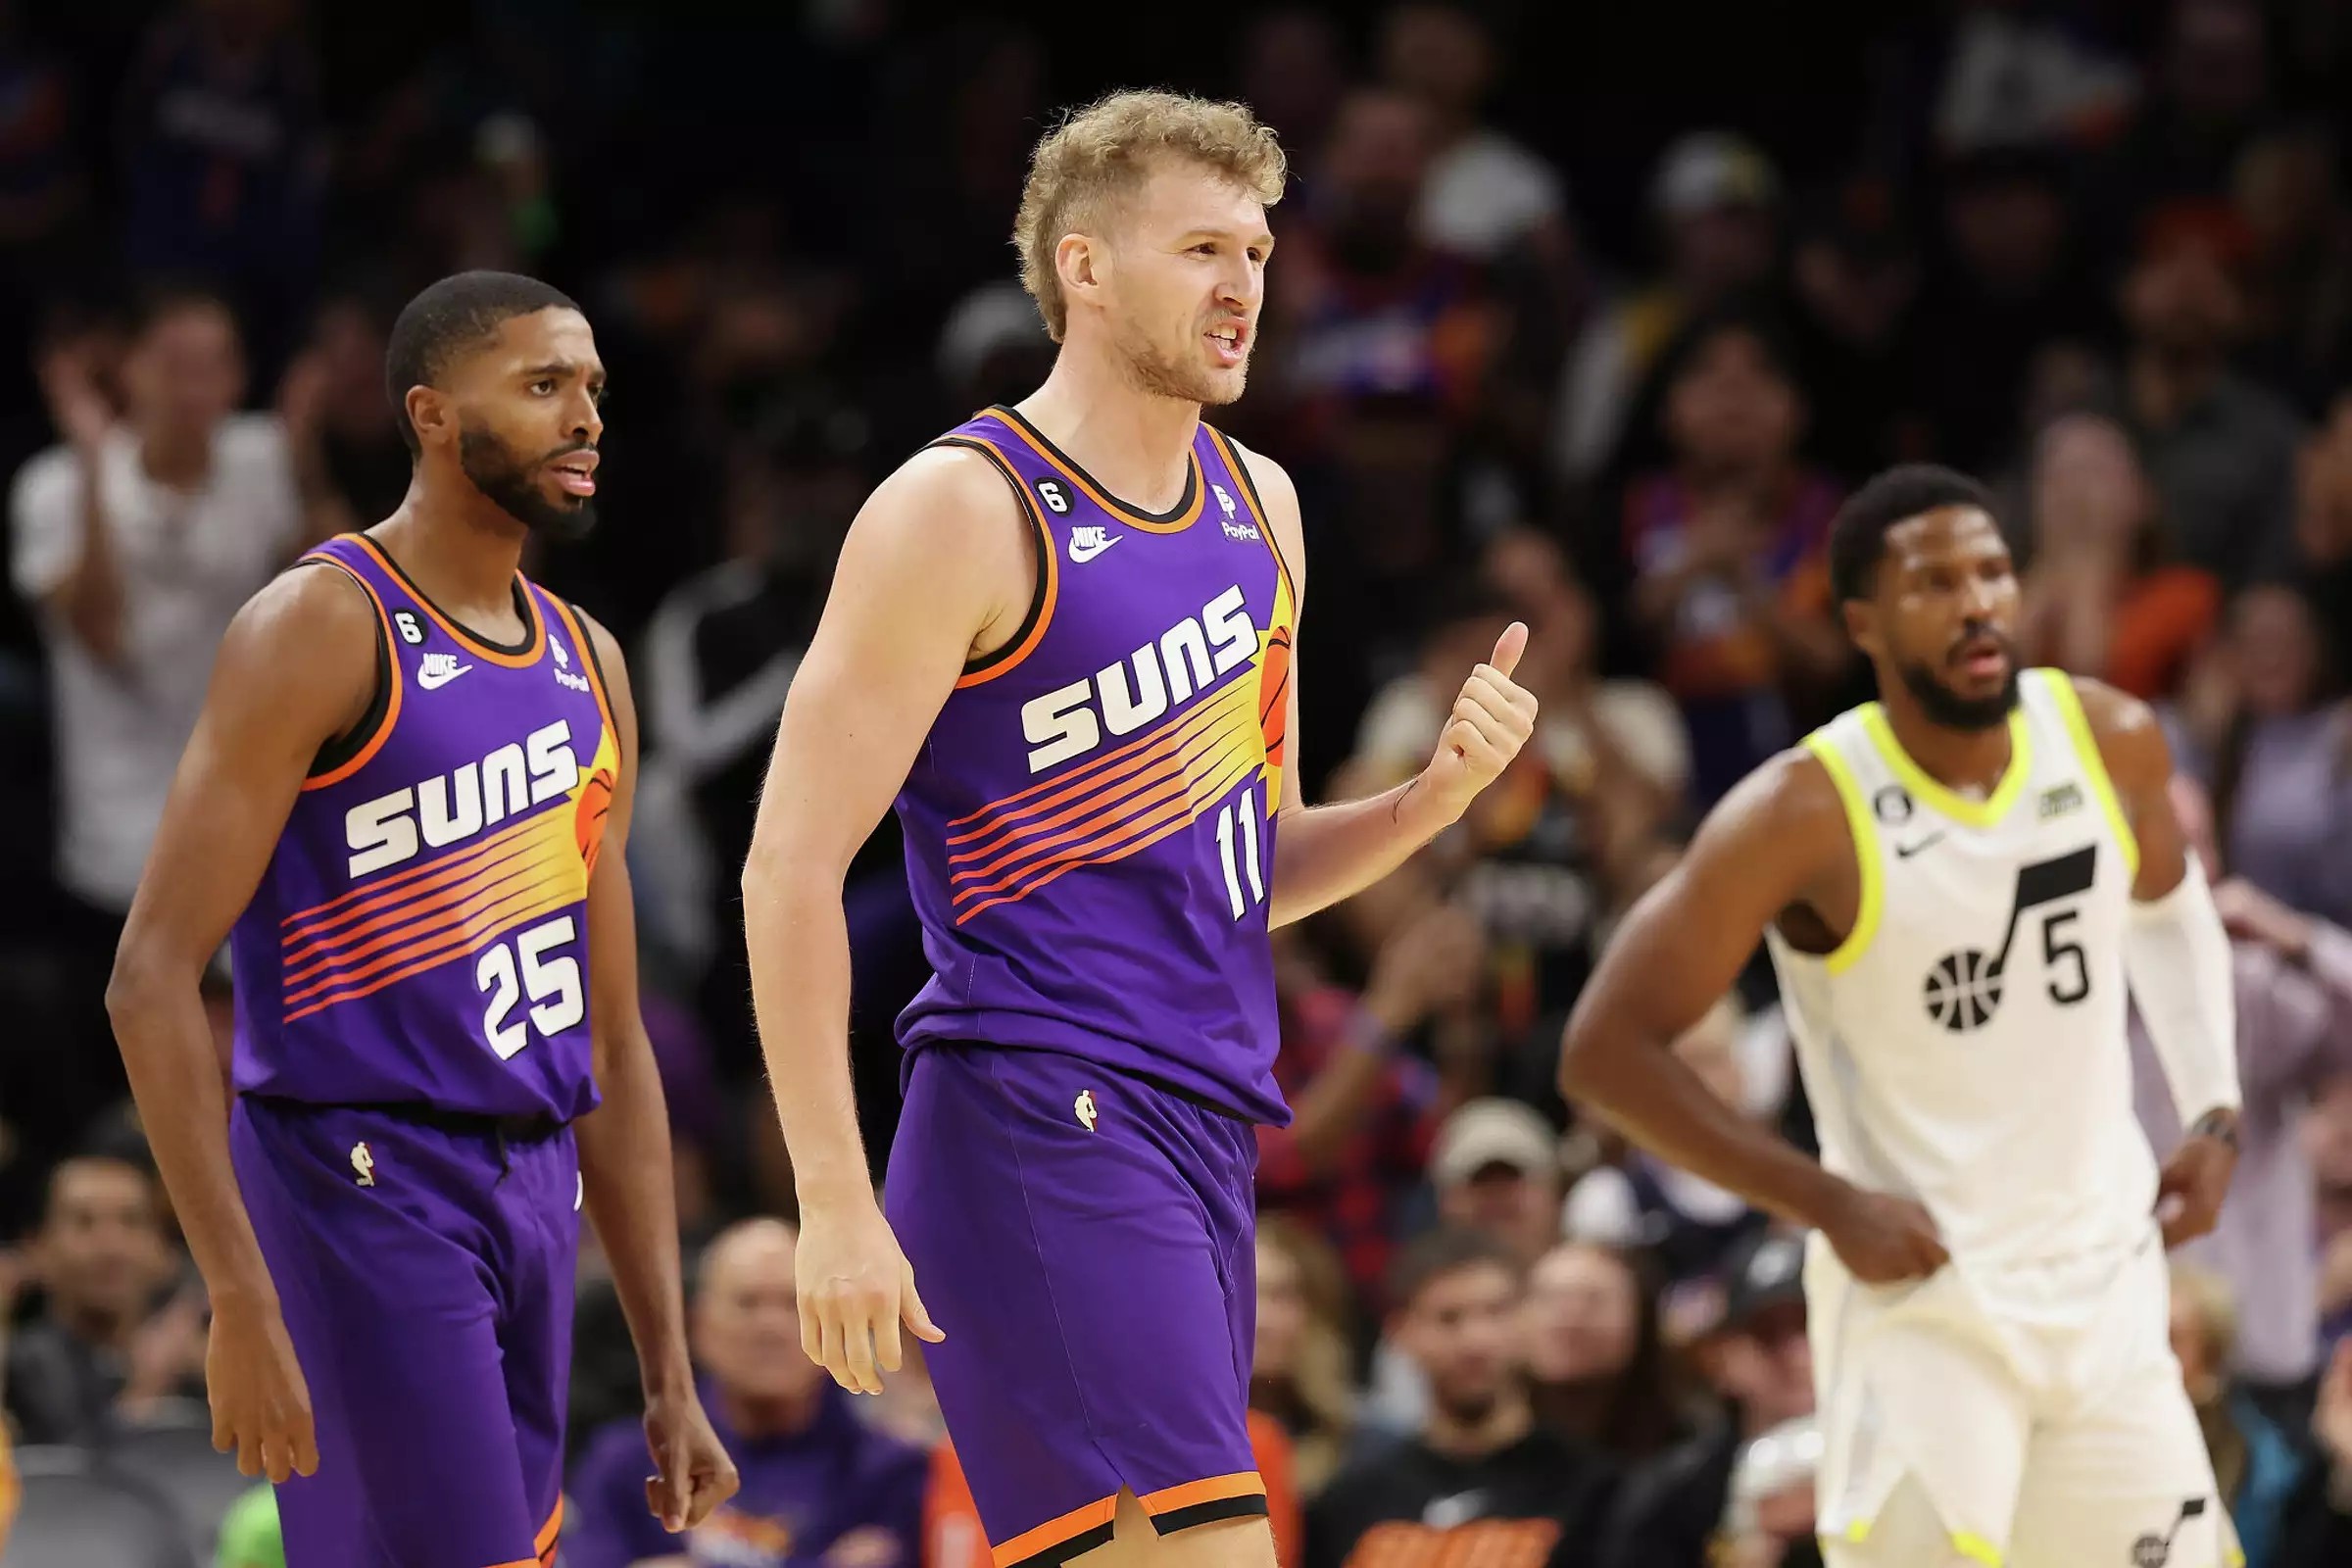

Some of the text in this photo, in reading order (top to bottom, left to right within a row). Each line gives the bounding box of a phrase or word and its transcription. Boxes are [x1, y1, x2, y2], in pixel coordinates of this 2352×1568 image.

[1038, 481, 1068, 513] 6
[1071, 525, 1107, 549] NIKE
[1222, 521, 1260, 540] PayPal
[394, 612, 422, 644] 6
[422, 652, 459, 675] NIKE
[1215, 787, 1265, 922] 11
[2043, 910, 2089, 1004] 5
[475, 914, 585, 1060] 25
